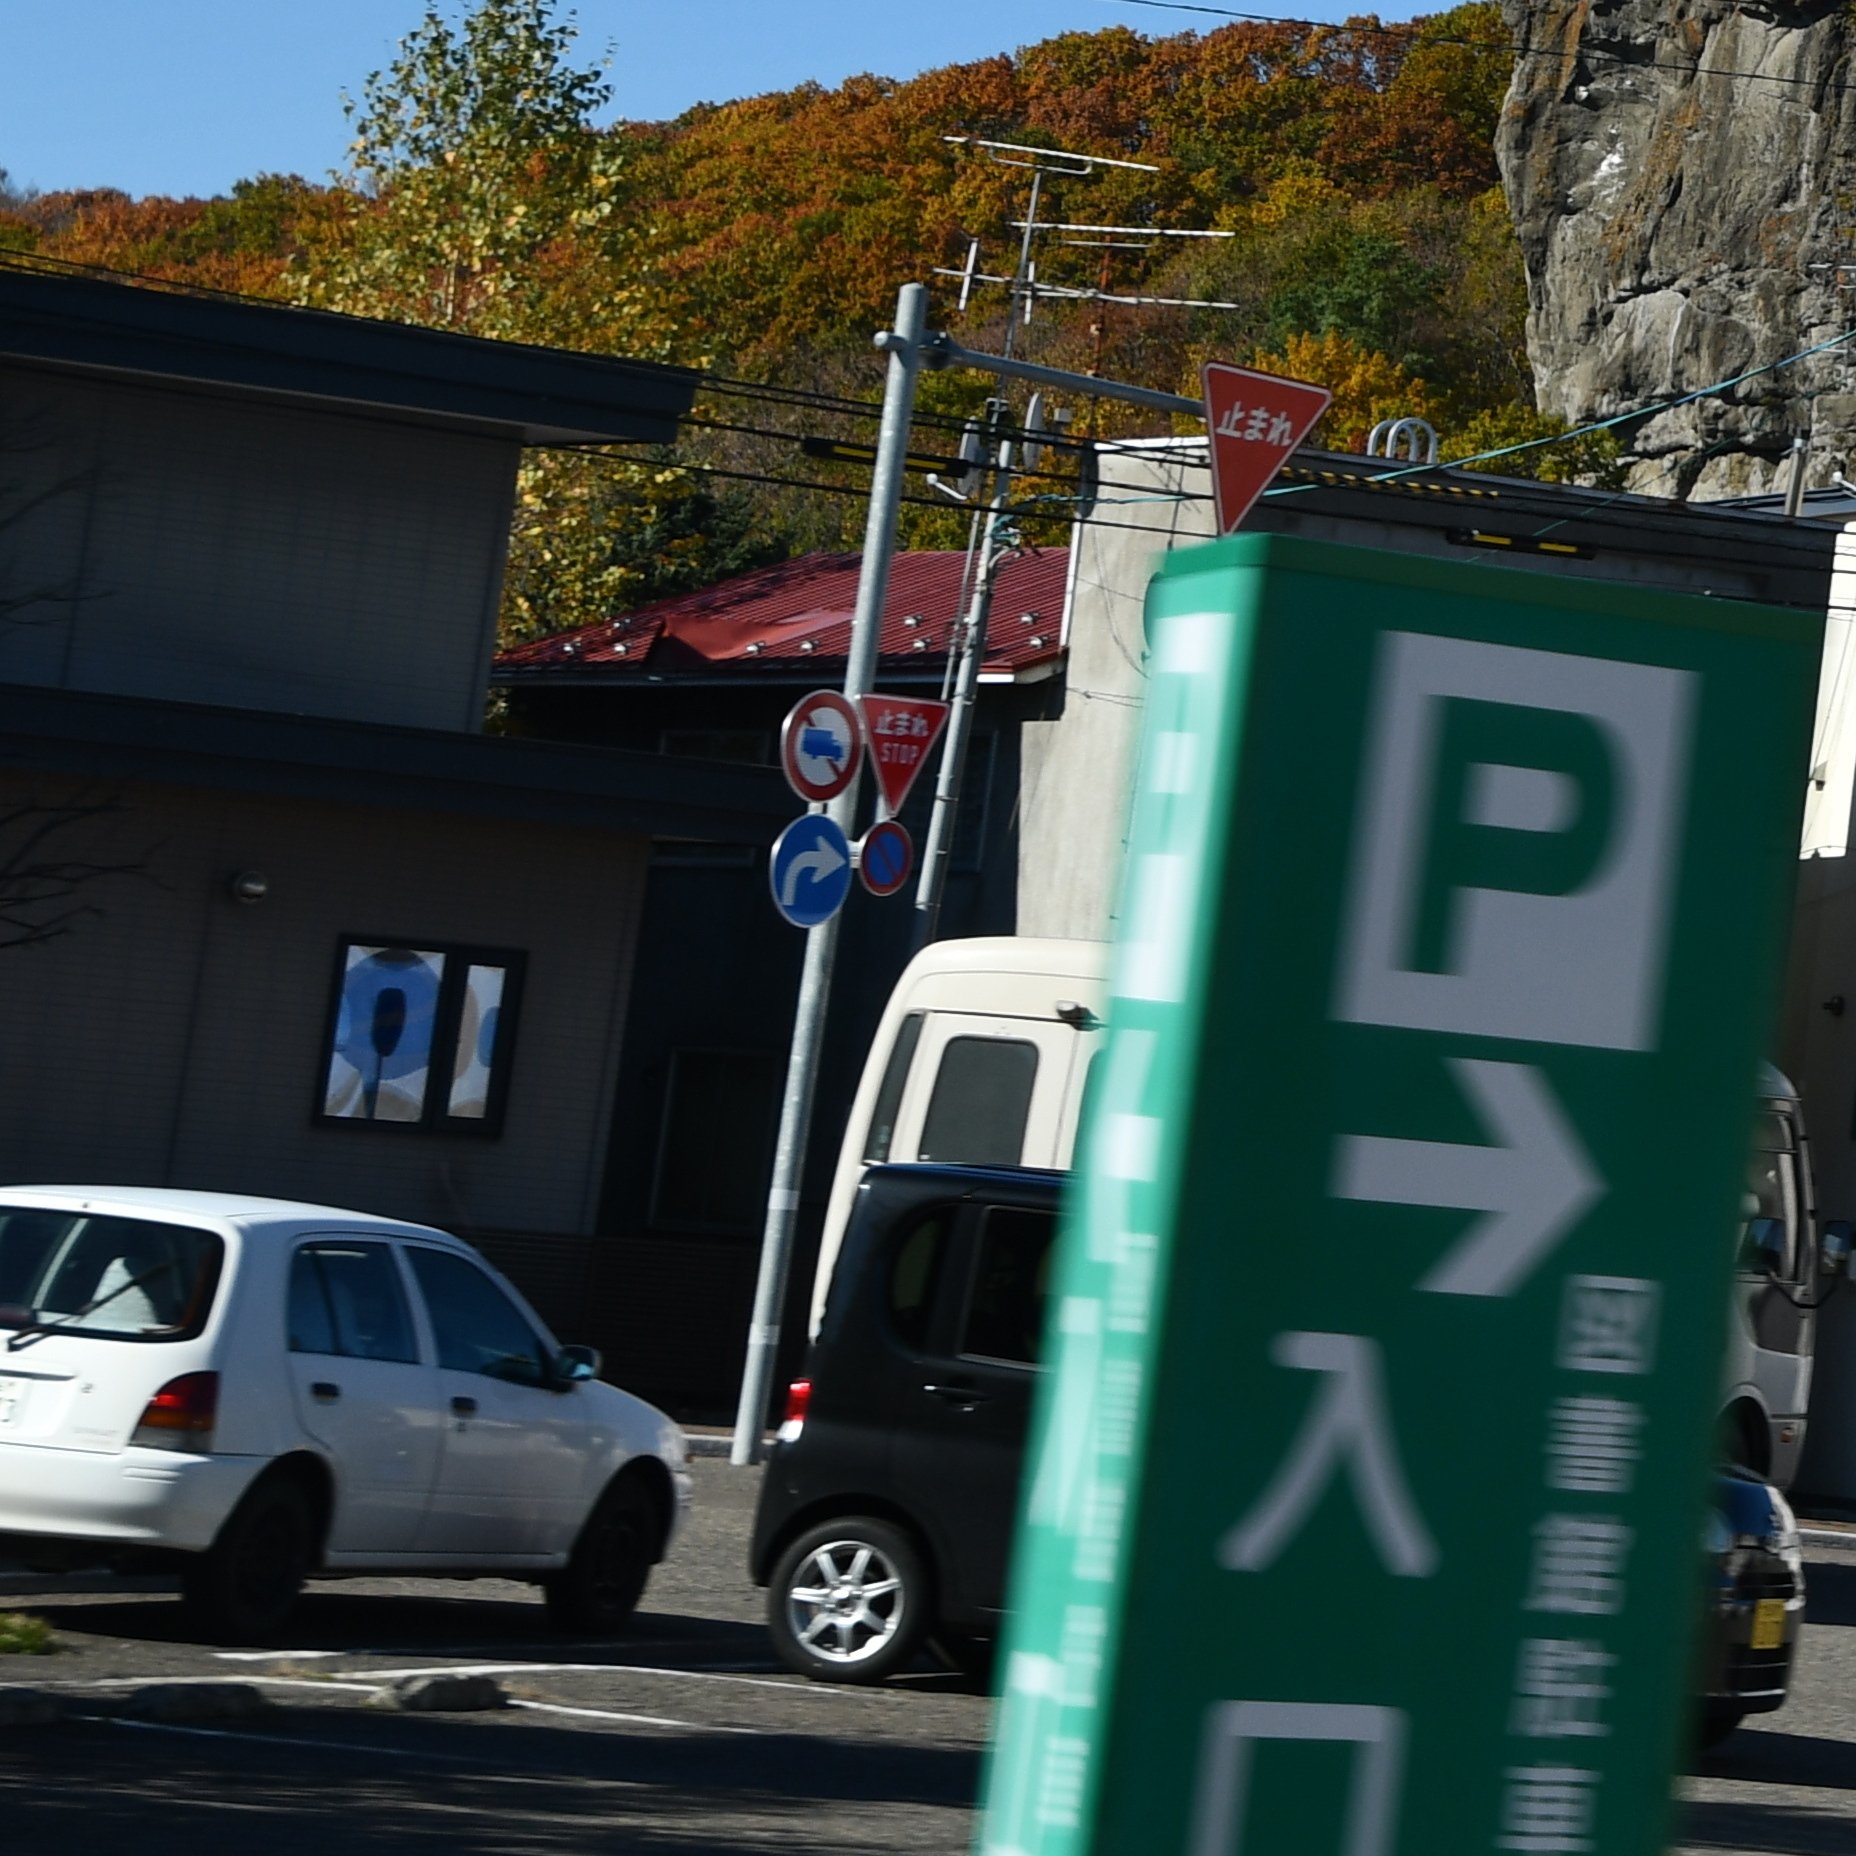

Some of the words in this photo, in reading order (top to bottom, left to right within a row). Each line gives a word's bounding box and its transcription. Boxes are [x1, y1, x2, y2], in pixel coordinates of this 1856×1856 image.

[1215, 401, 1293, 447] 止まれ
[874, 709, 929, 737] 止まれ
[880, 742, 919, 764] STOP
[1396, 694, 1634, 980] P
